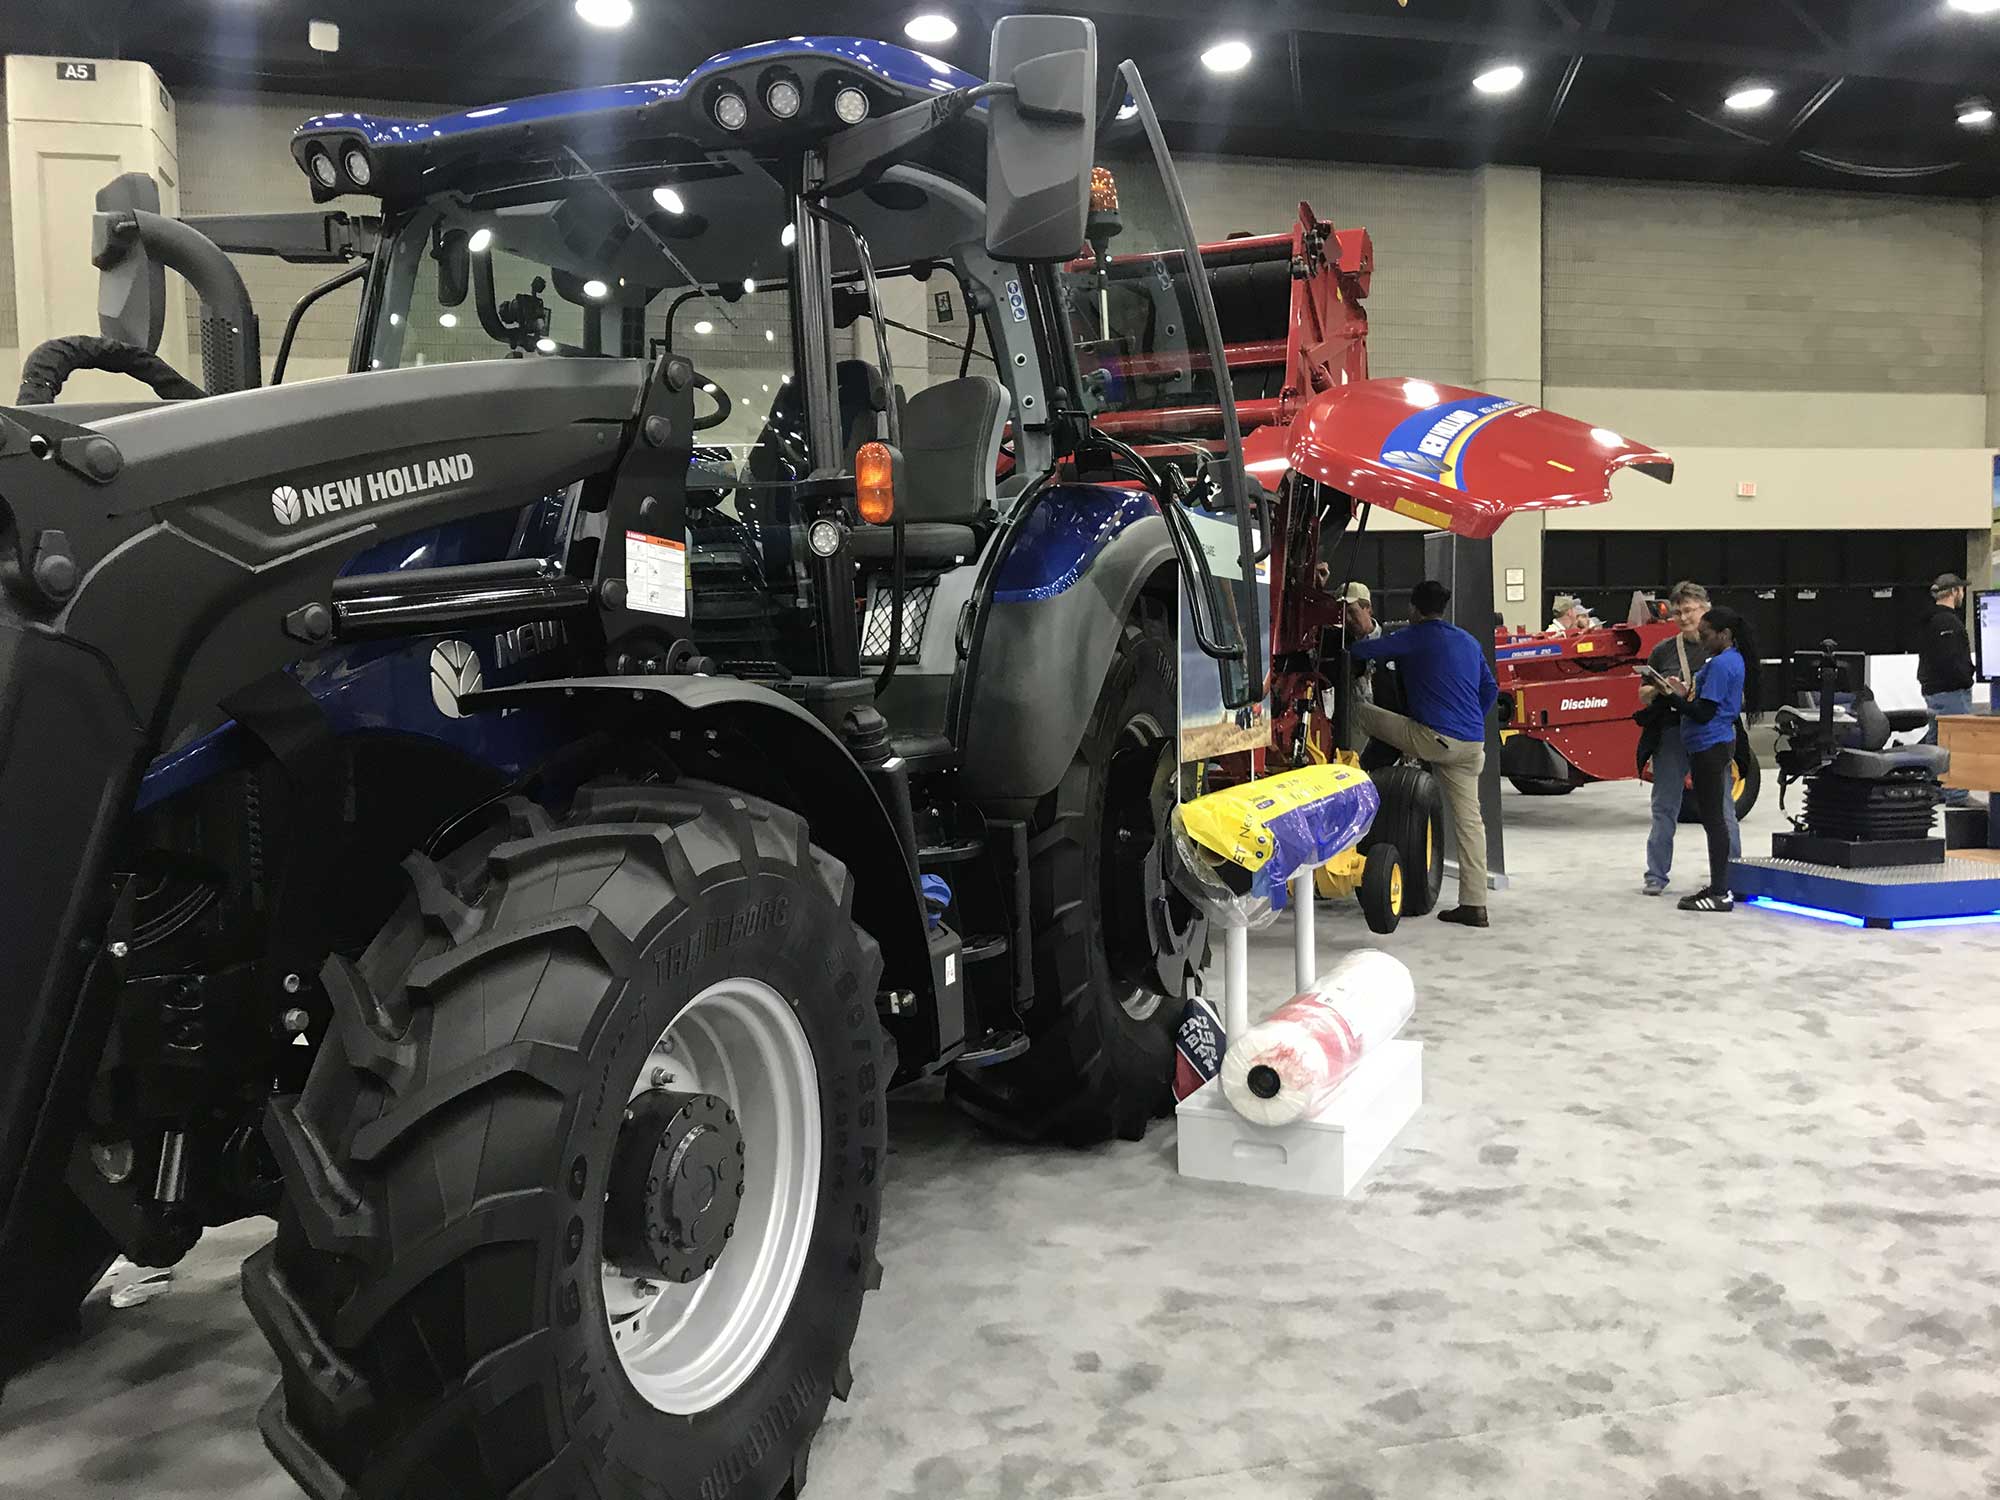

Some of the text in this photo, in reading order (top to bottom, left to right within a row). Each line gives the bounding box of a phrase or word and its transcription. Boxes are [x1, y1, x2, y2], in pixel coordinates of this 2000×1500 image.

[65, 64, 88, 79] A5
[302, 453, 474, 518] NEW HOLLAND
[1560, 697, 1608, 711] Discbine
